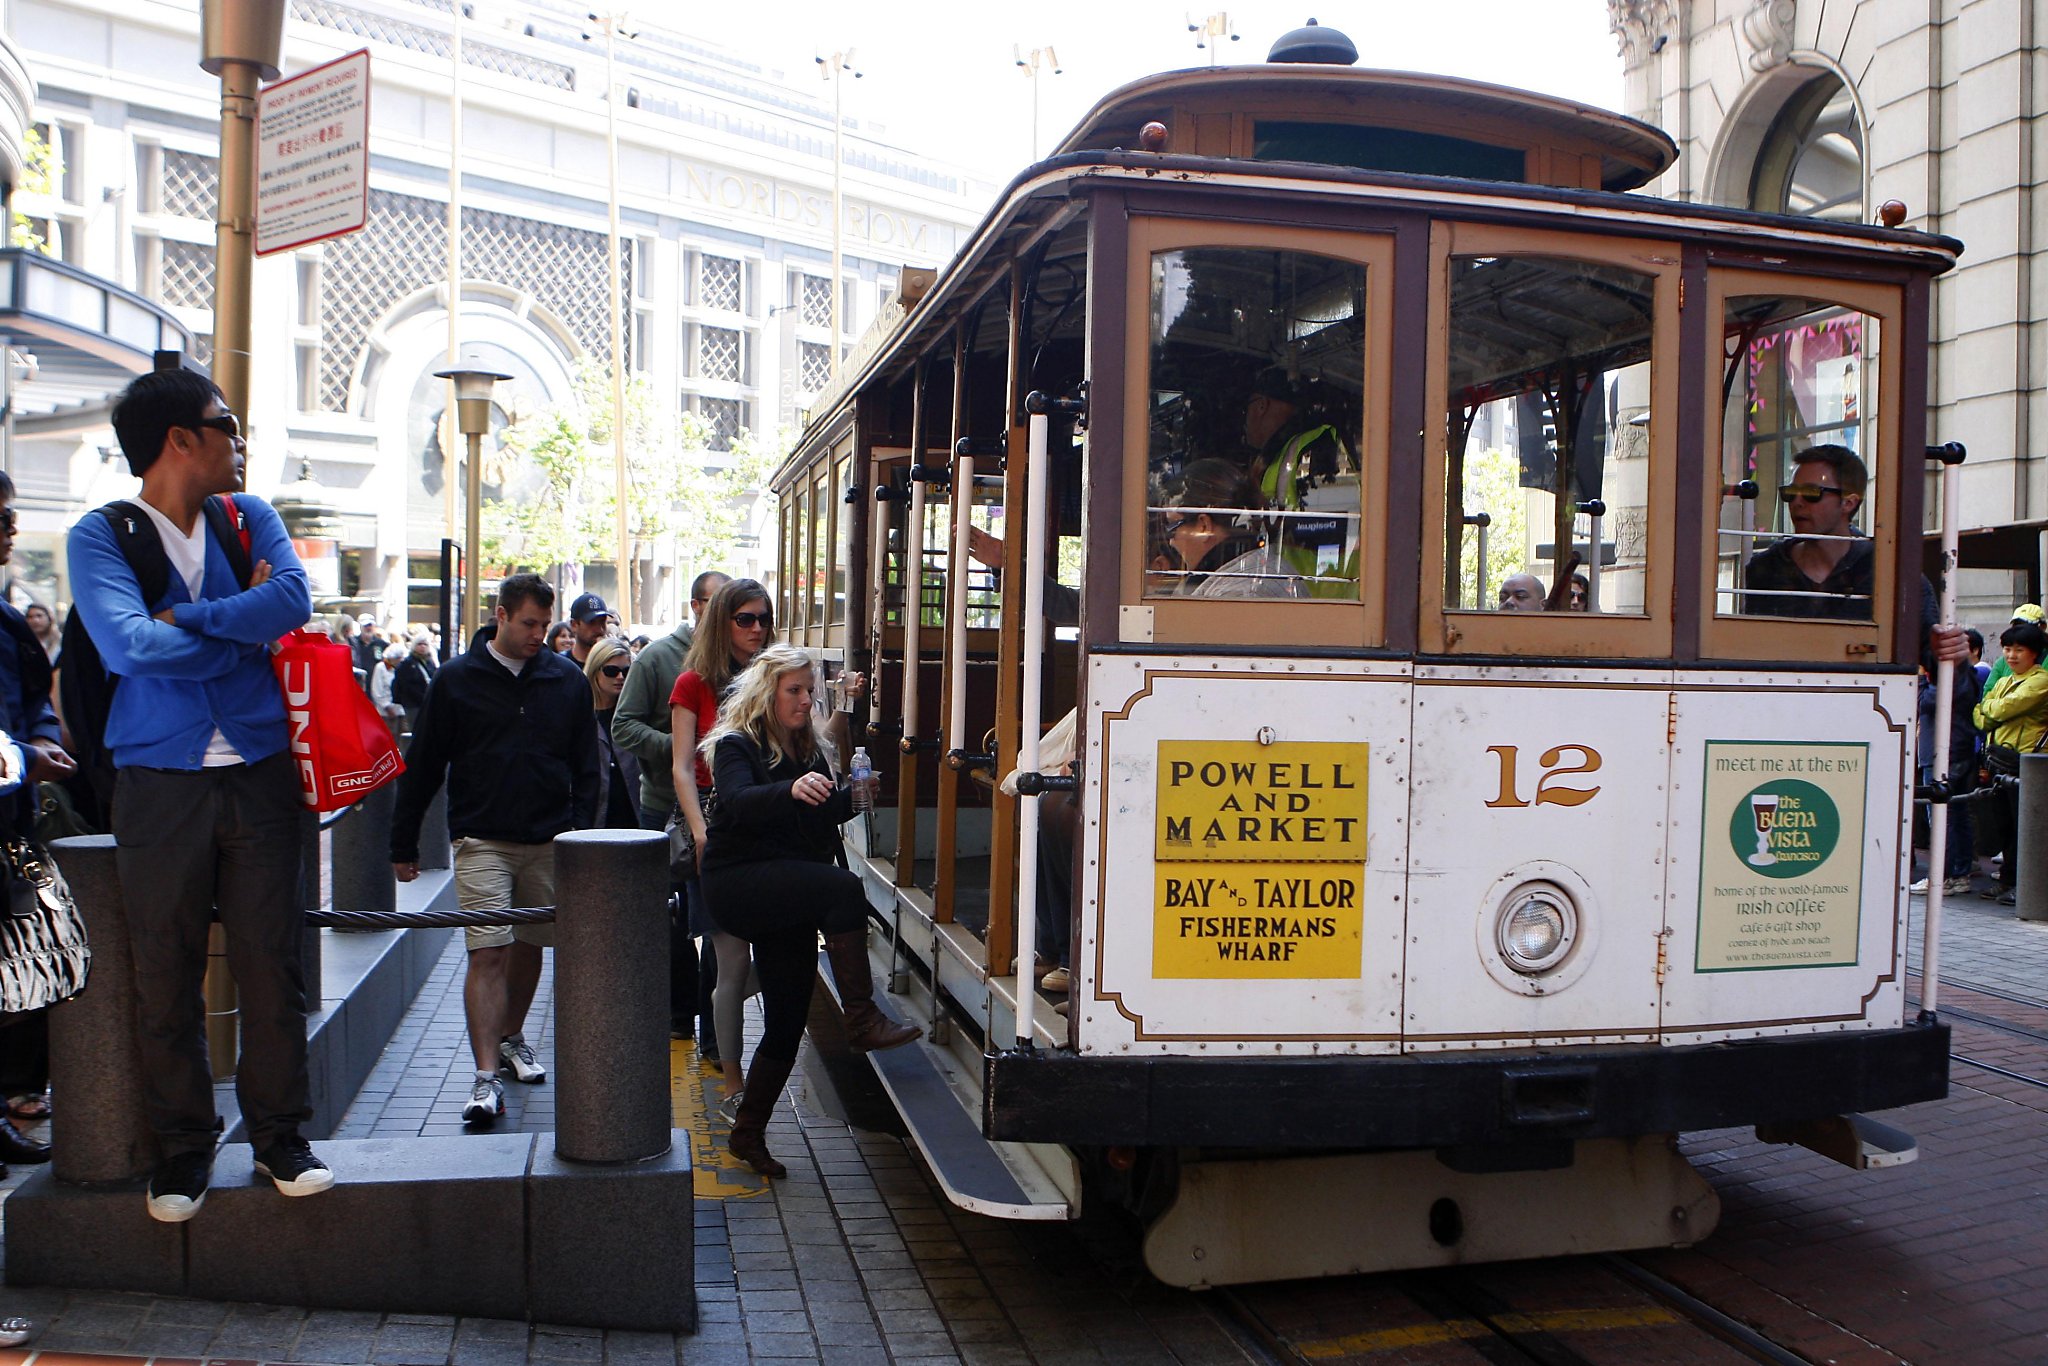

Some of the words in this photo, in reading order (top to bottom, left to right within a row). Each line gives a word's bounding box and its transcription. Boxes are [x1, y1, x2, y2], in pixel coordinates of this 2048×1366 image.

[283, 661, 319, 806] GNC
[336, 775, 373, 788] GNC
[1170, 761, 1355, 789] POWELL
[1483, 743, 1603, 808] 12
[1218, 792, 1311, 813] AND
[1165, 816, 1358, 843] MARKET
[1164, 878, 1216, 908] BAY
[1218, 879, 1248, 907] AND
[1253, 878, 1356, 908] TAYLOR
[1179, 916, 1337, 938] FISHERMANS
[1216, 941, 1298, 962] WHARF
